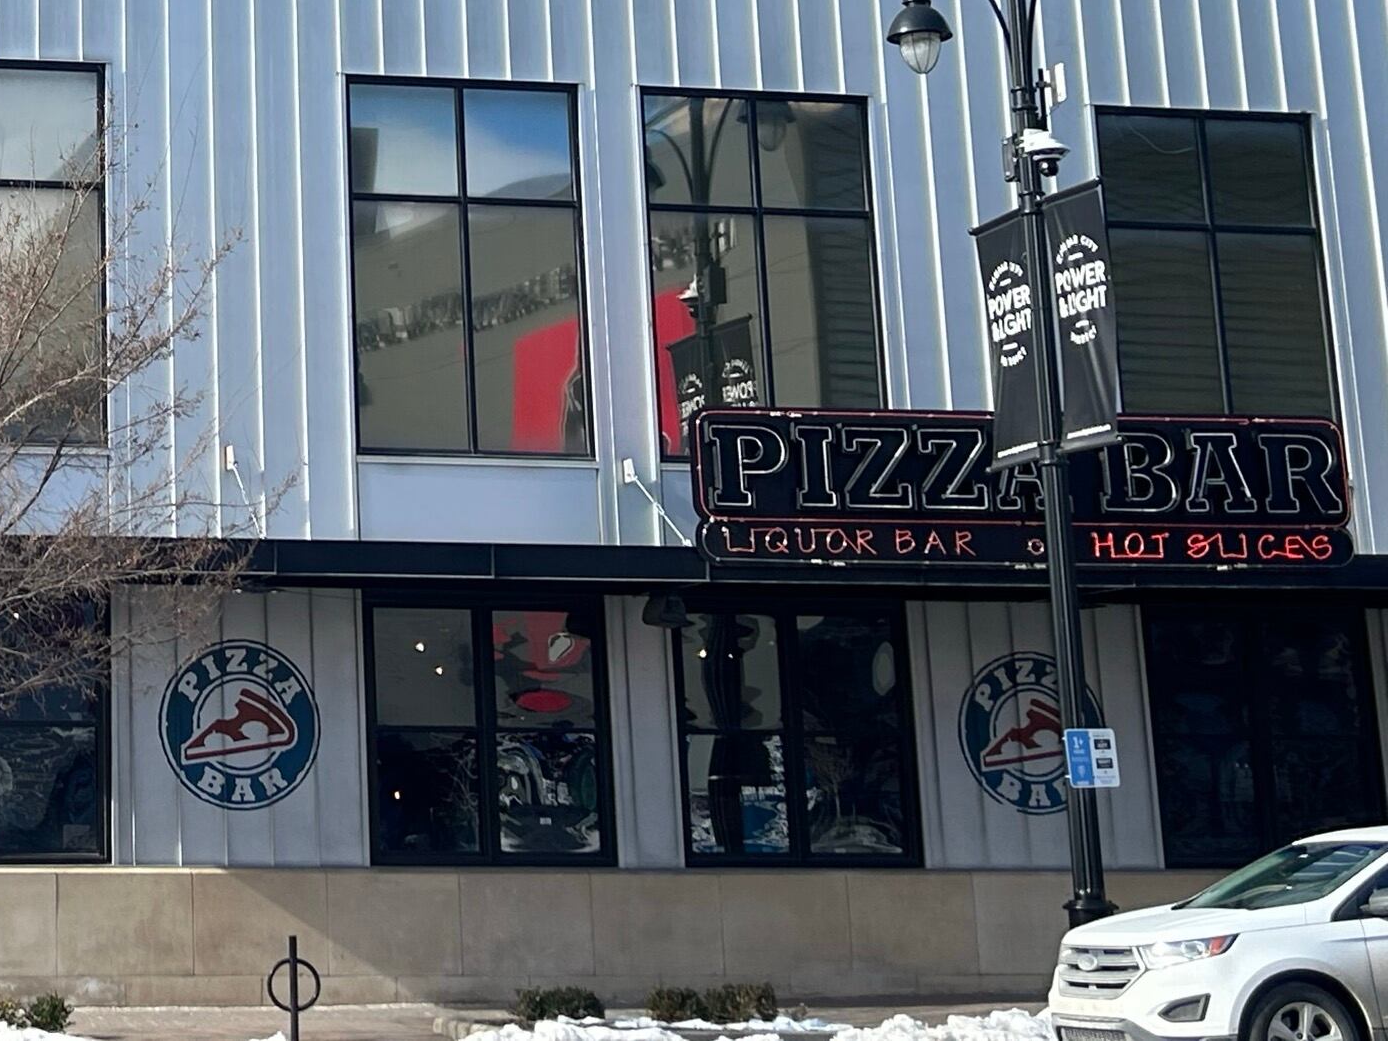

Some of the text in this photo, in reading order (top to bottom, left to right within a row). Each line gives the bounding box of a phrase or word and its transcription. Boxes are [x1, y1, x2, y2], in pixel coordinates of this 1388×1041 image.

[1054, 260, 1107, 295] POWER
[1099, 431, 1345, 514] BAR
[722, 527, 1332, 559] LIQUOR BAR HOT SLICES
[177, 648, 303, 705] PIZZA
[975, 660, 1059, 712] PIZZ
[197, 765, 289, 802] BAR
